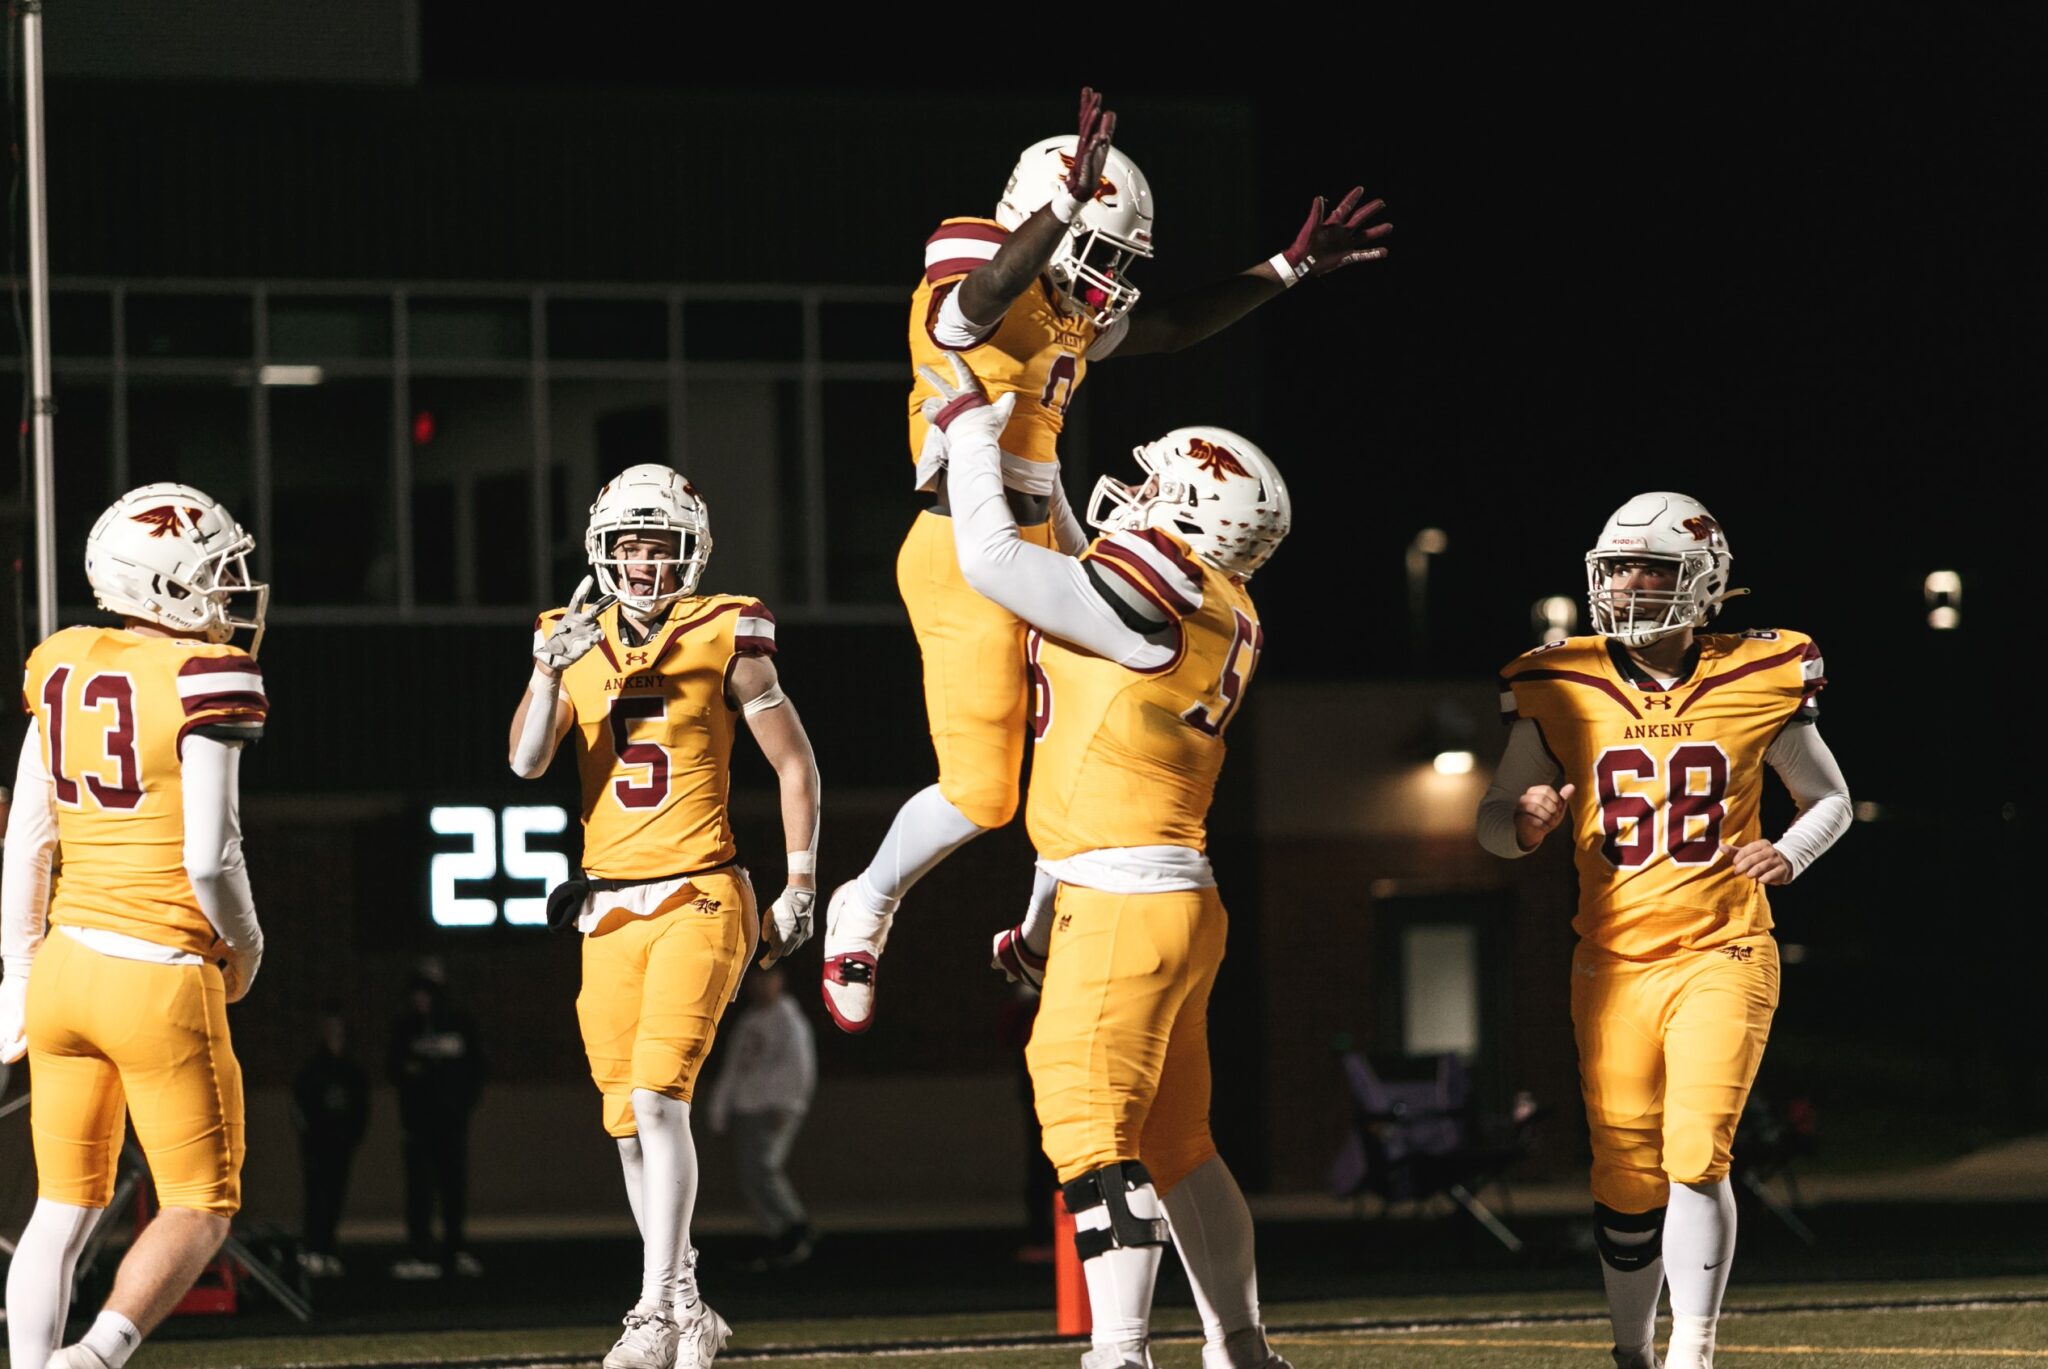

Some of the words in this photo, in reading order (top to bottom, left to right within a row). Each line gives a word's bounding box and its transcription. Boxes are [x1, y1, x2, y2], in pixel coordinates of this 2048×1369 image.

[604, 675, 666, 691] ANKENY
[1180, 607, 1264, 738] 5
[1624, 723, 1694, 739] ANKENY
[40, 663, 147, 812] 13
[607, 695, 670, 812] 5
[429, 805, 569, 927] 25
[1593, 740, 1731, 871] 68
